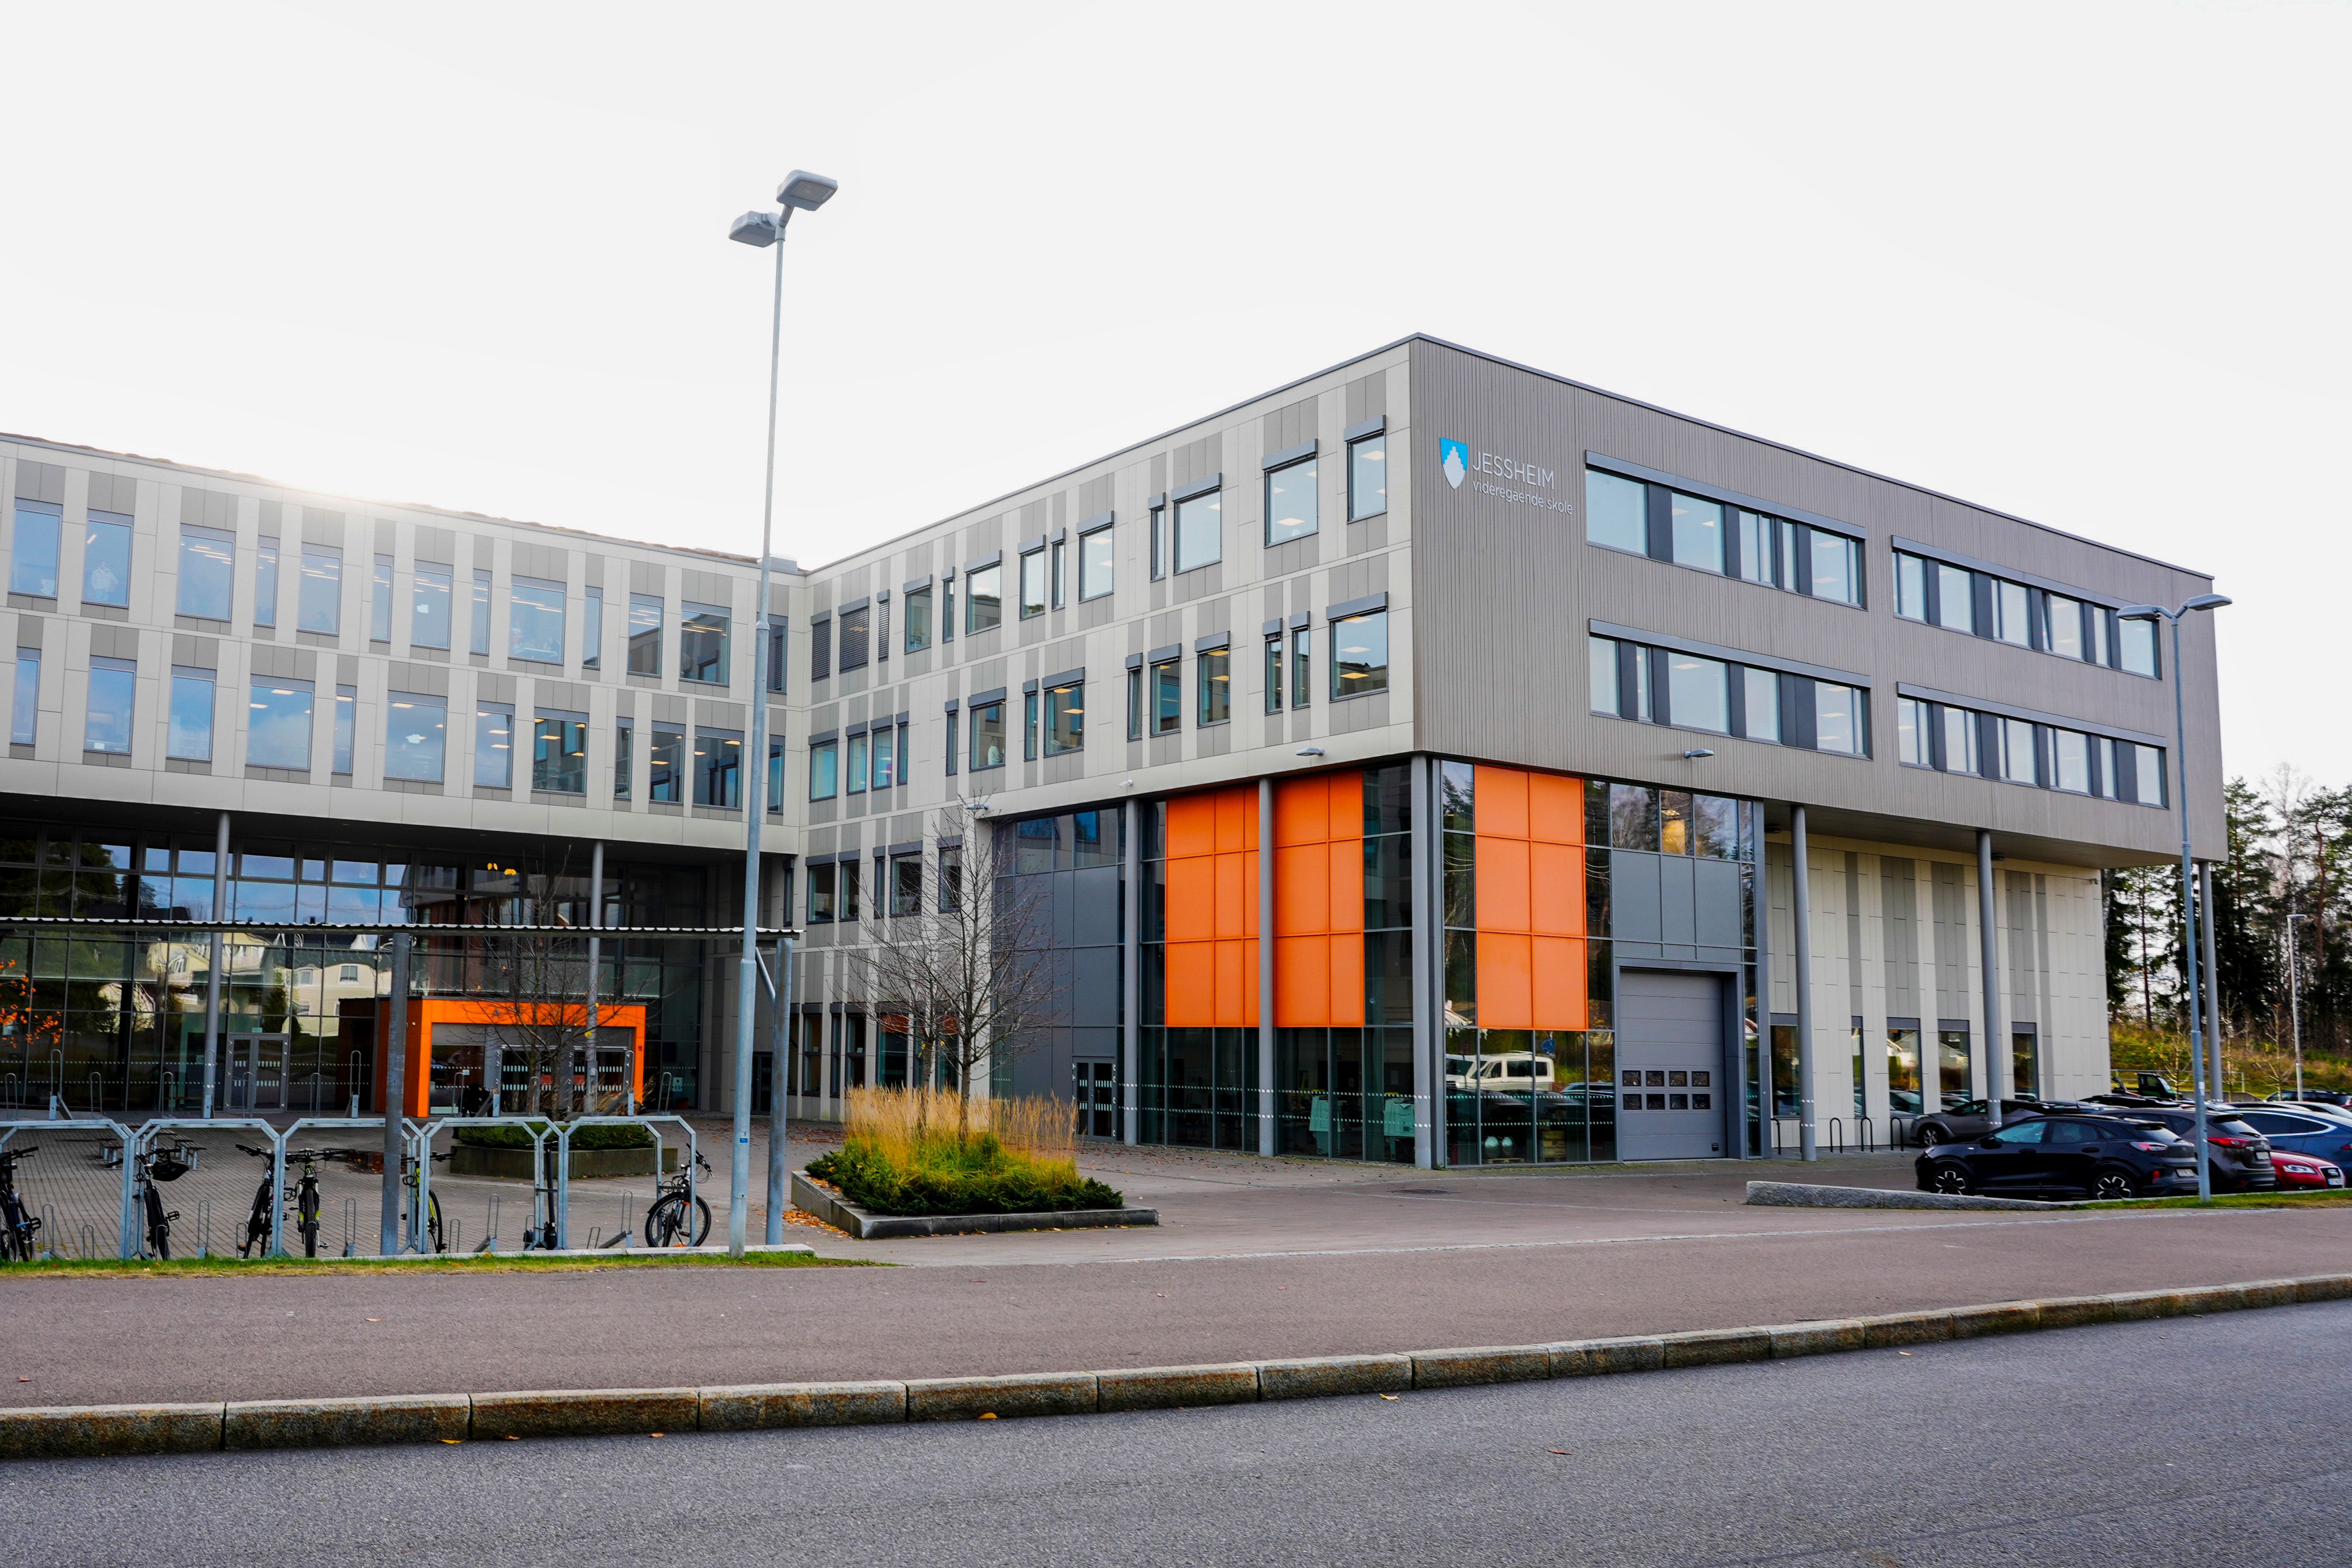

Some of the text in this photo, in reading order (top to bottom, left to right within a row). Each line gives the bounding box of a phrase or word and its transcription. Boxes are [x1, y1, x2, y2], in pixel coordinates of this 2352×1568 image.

[1472, 451, 1555, 490] JESSHEIM
[1472, 480, 1573, 515] videregående skole
